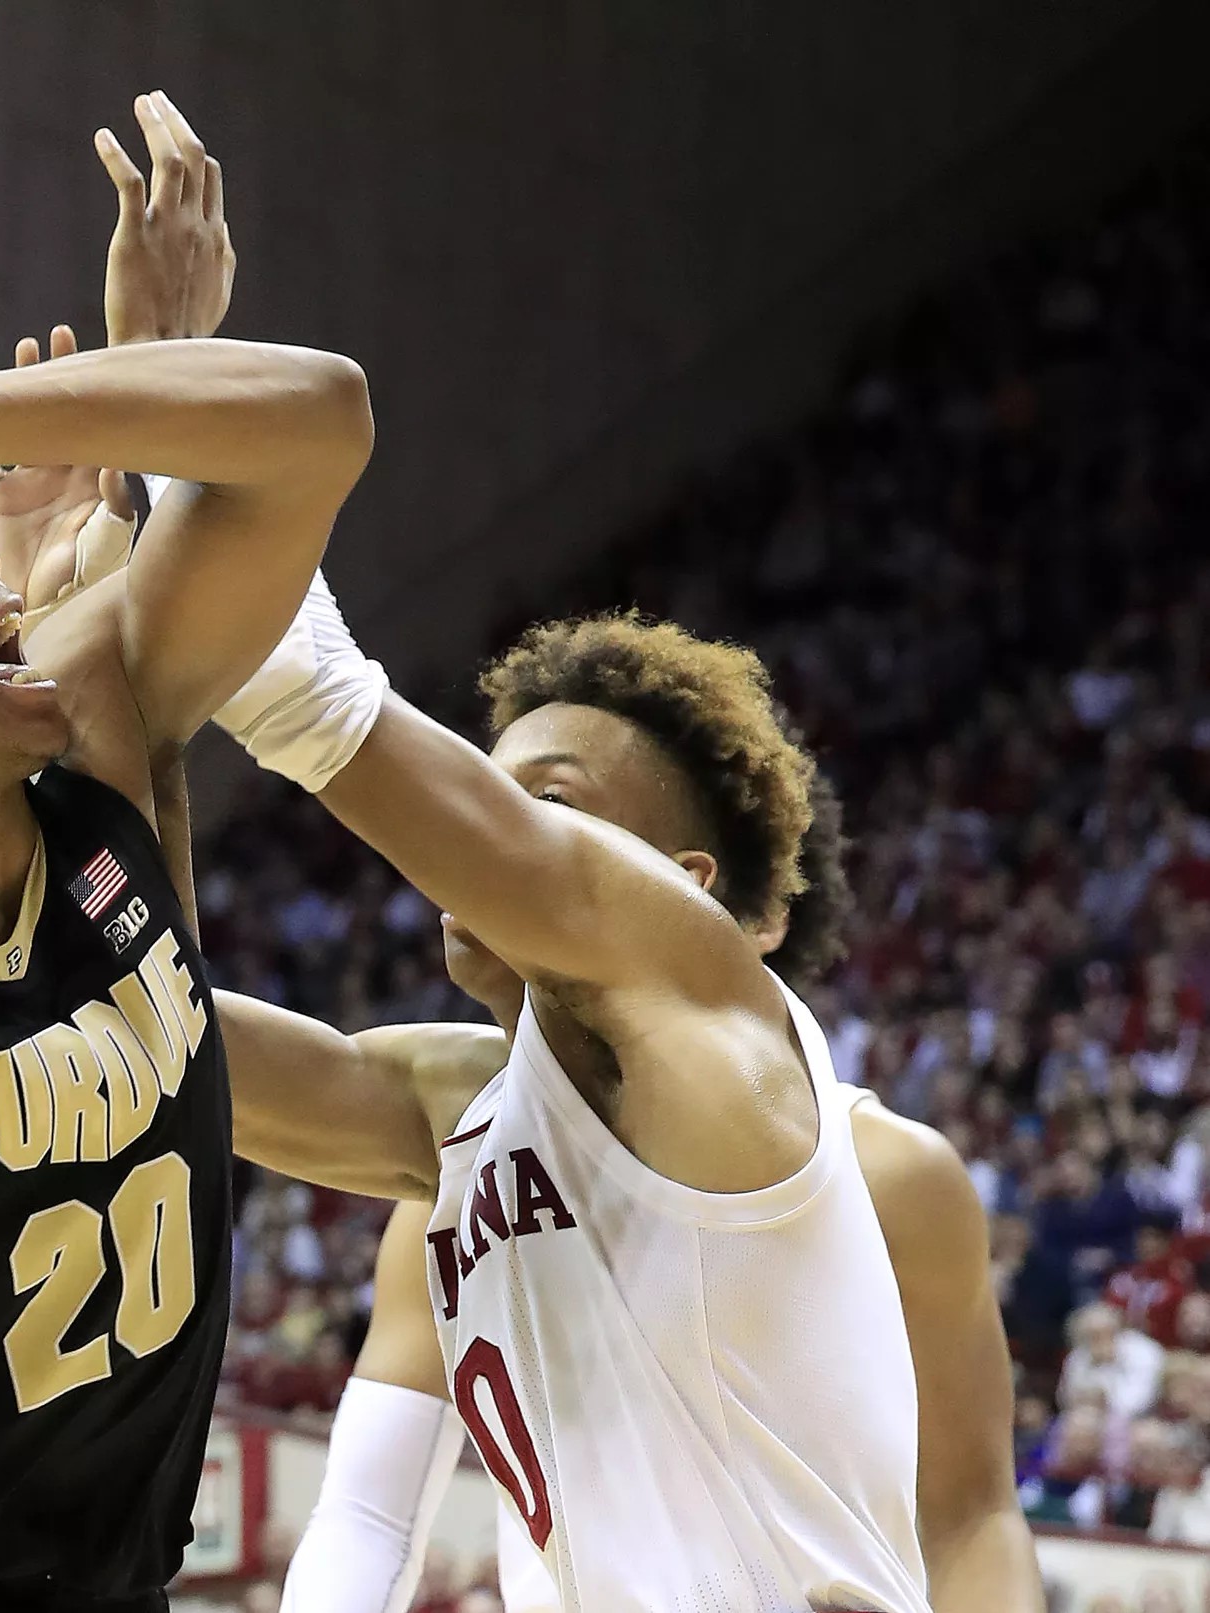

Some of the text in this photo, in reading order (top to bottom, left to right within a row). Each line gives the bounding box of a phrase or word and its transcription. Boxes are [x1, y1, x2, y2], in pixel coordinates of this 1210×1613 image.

[6, 945, 22, 976] P
[2, 1150, 196, 1413] 20
[454, 1336, 553, 1552] 0
